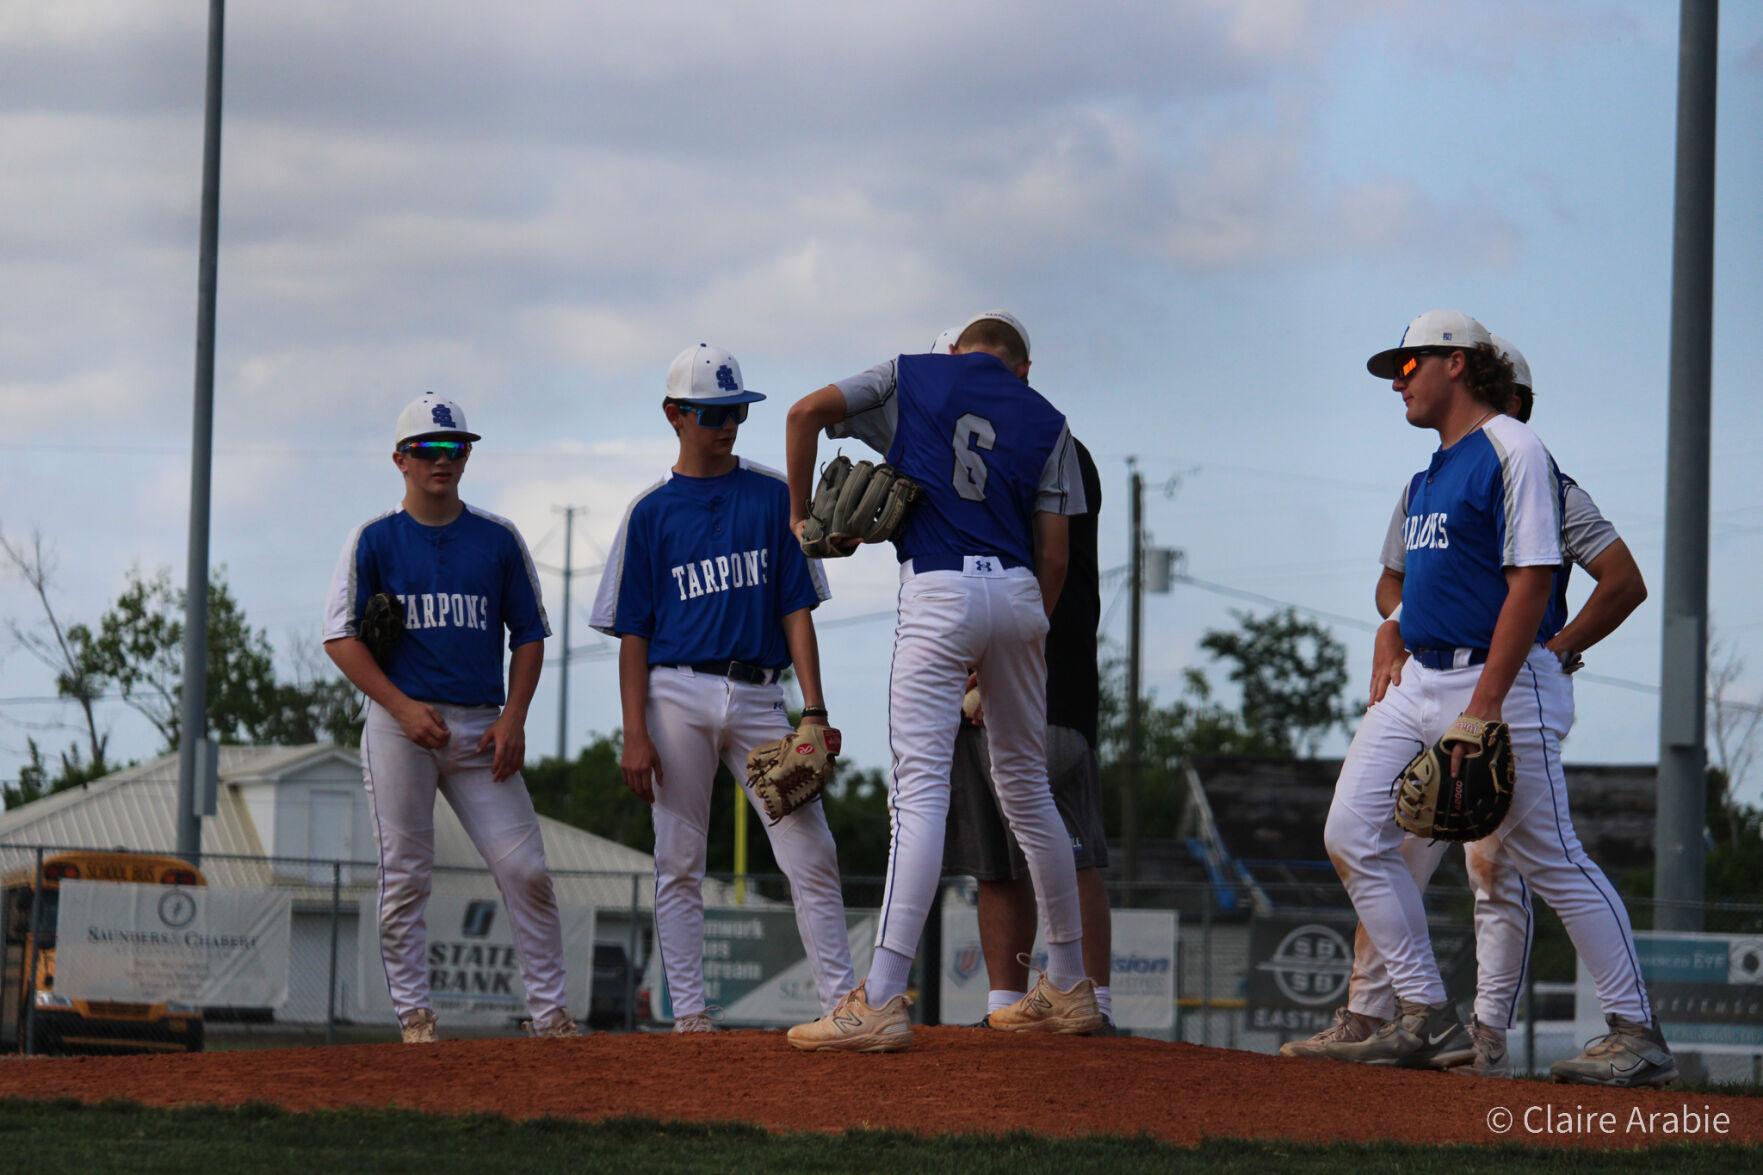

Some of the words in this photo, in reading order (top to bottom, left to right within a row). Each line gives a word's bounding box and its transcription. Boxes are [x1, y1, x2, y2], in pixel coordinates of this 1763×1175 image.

[952, 412, 996, 501] 6
[671, 549, 768, 601] TARPONS
[428, 943, 517, 968] STATE
[1112, 951, 1169, 973] sion
[430, 969, 513, 994] BANK
